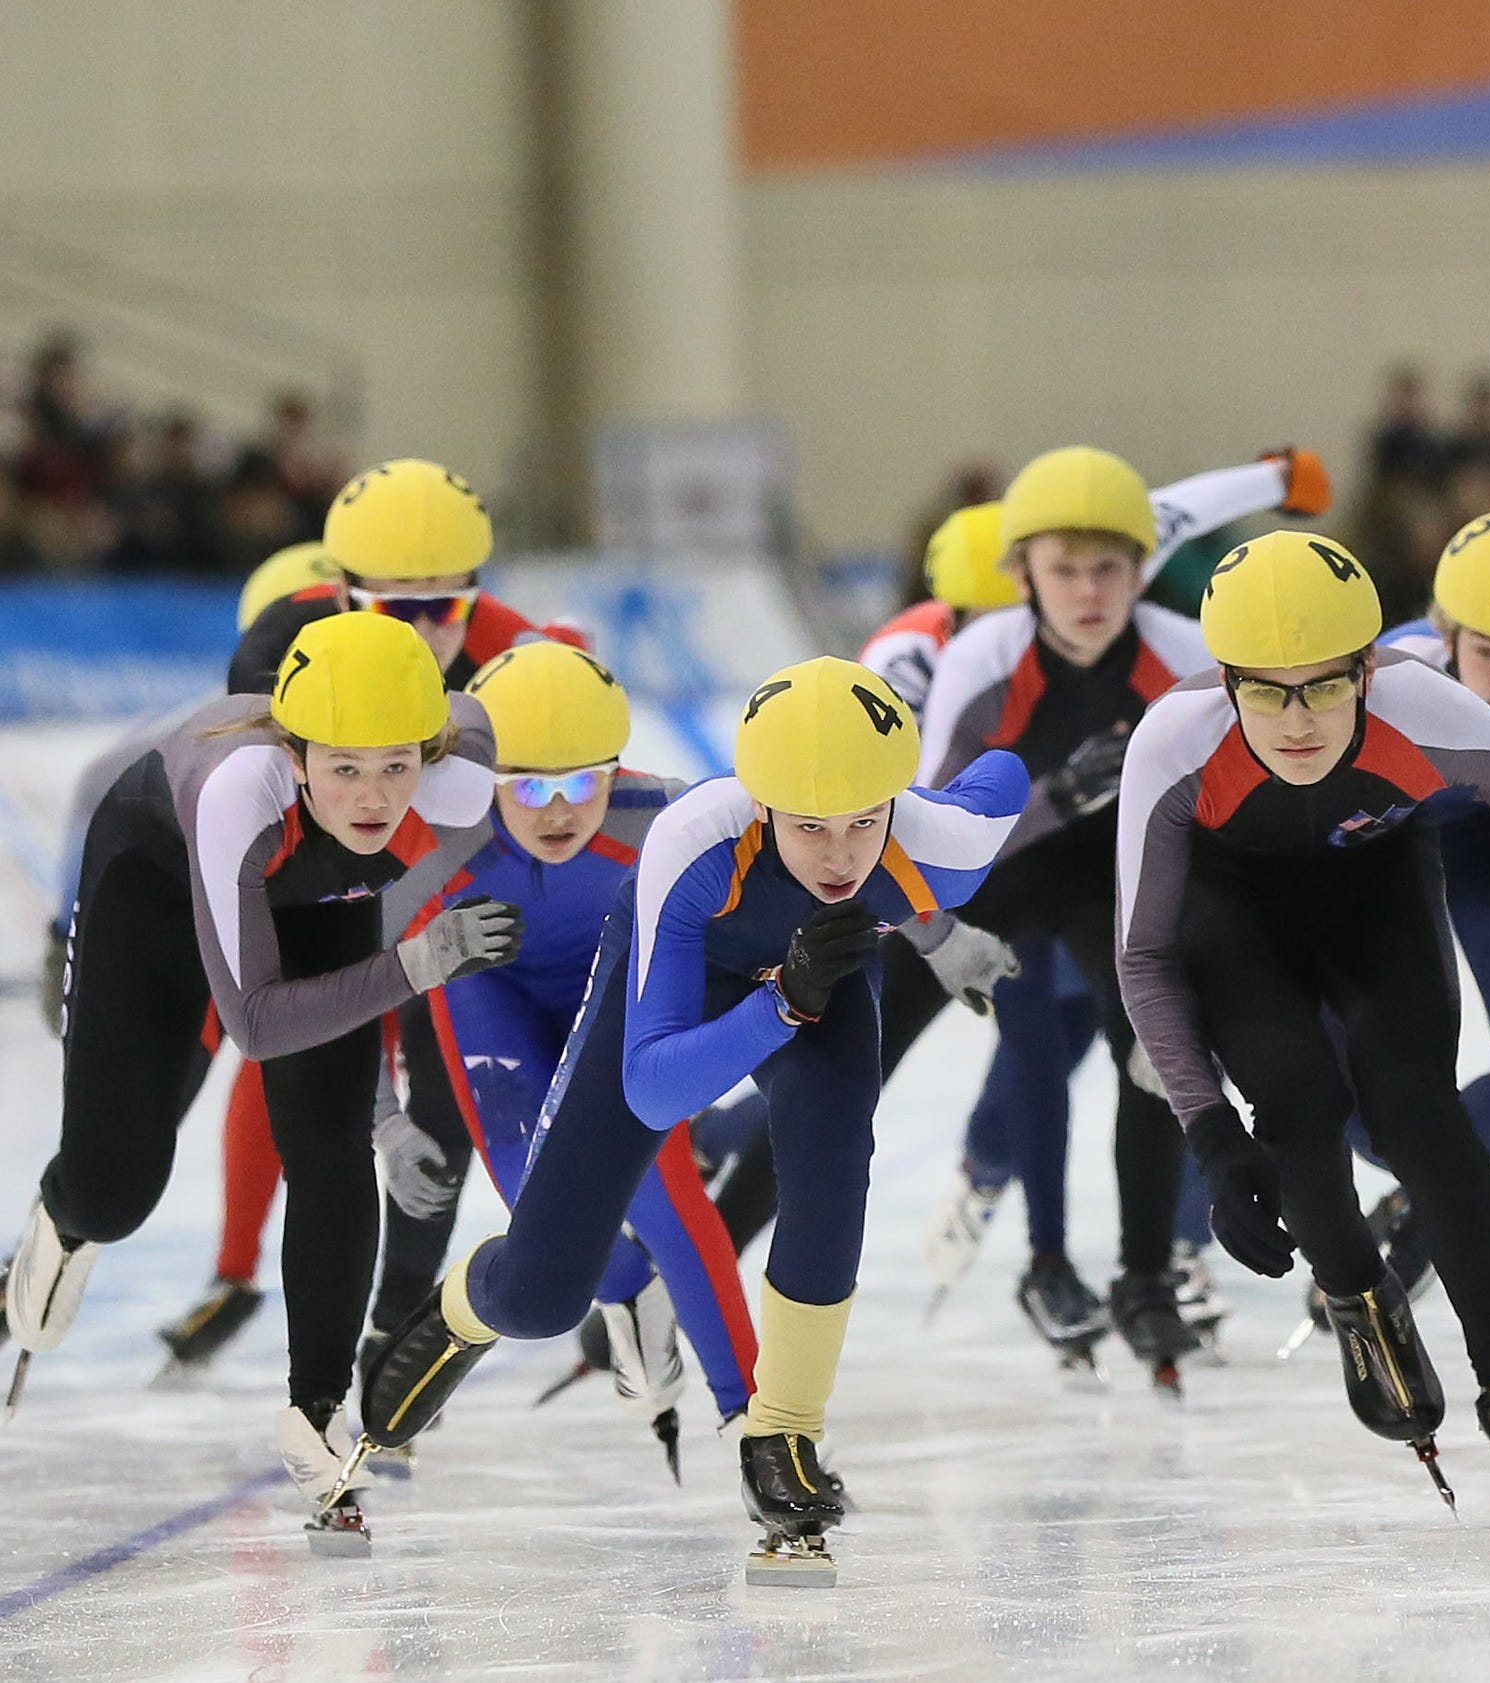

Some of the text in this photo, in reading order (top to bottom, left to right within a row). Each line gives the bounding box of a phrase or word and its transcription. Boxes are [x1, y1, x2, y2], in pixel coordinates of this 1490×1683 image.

[1308, 541, 1361, 582] 4
[279, 649, 311, 704] 7
[851, 684, 903, 736] 4
